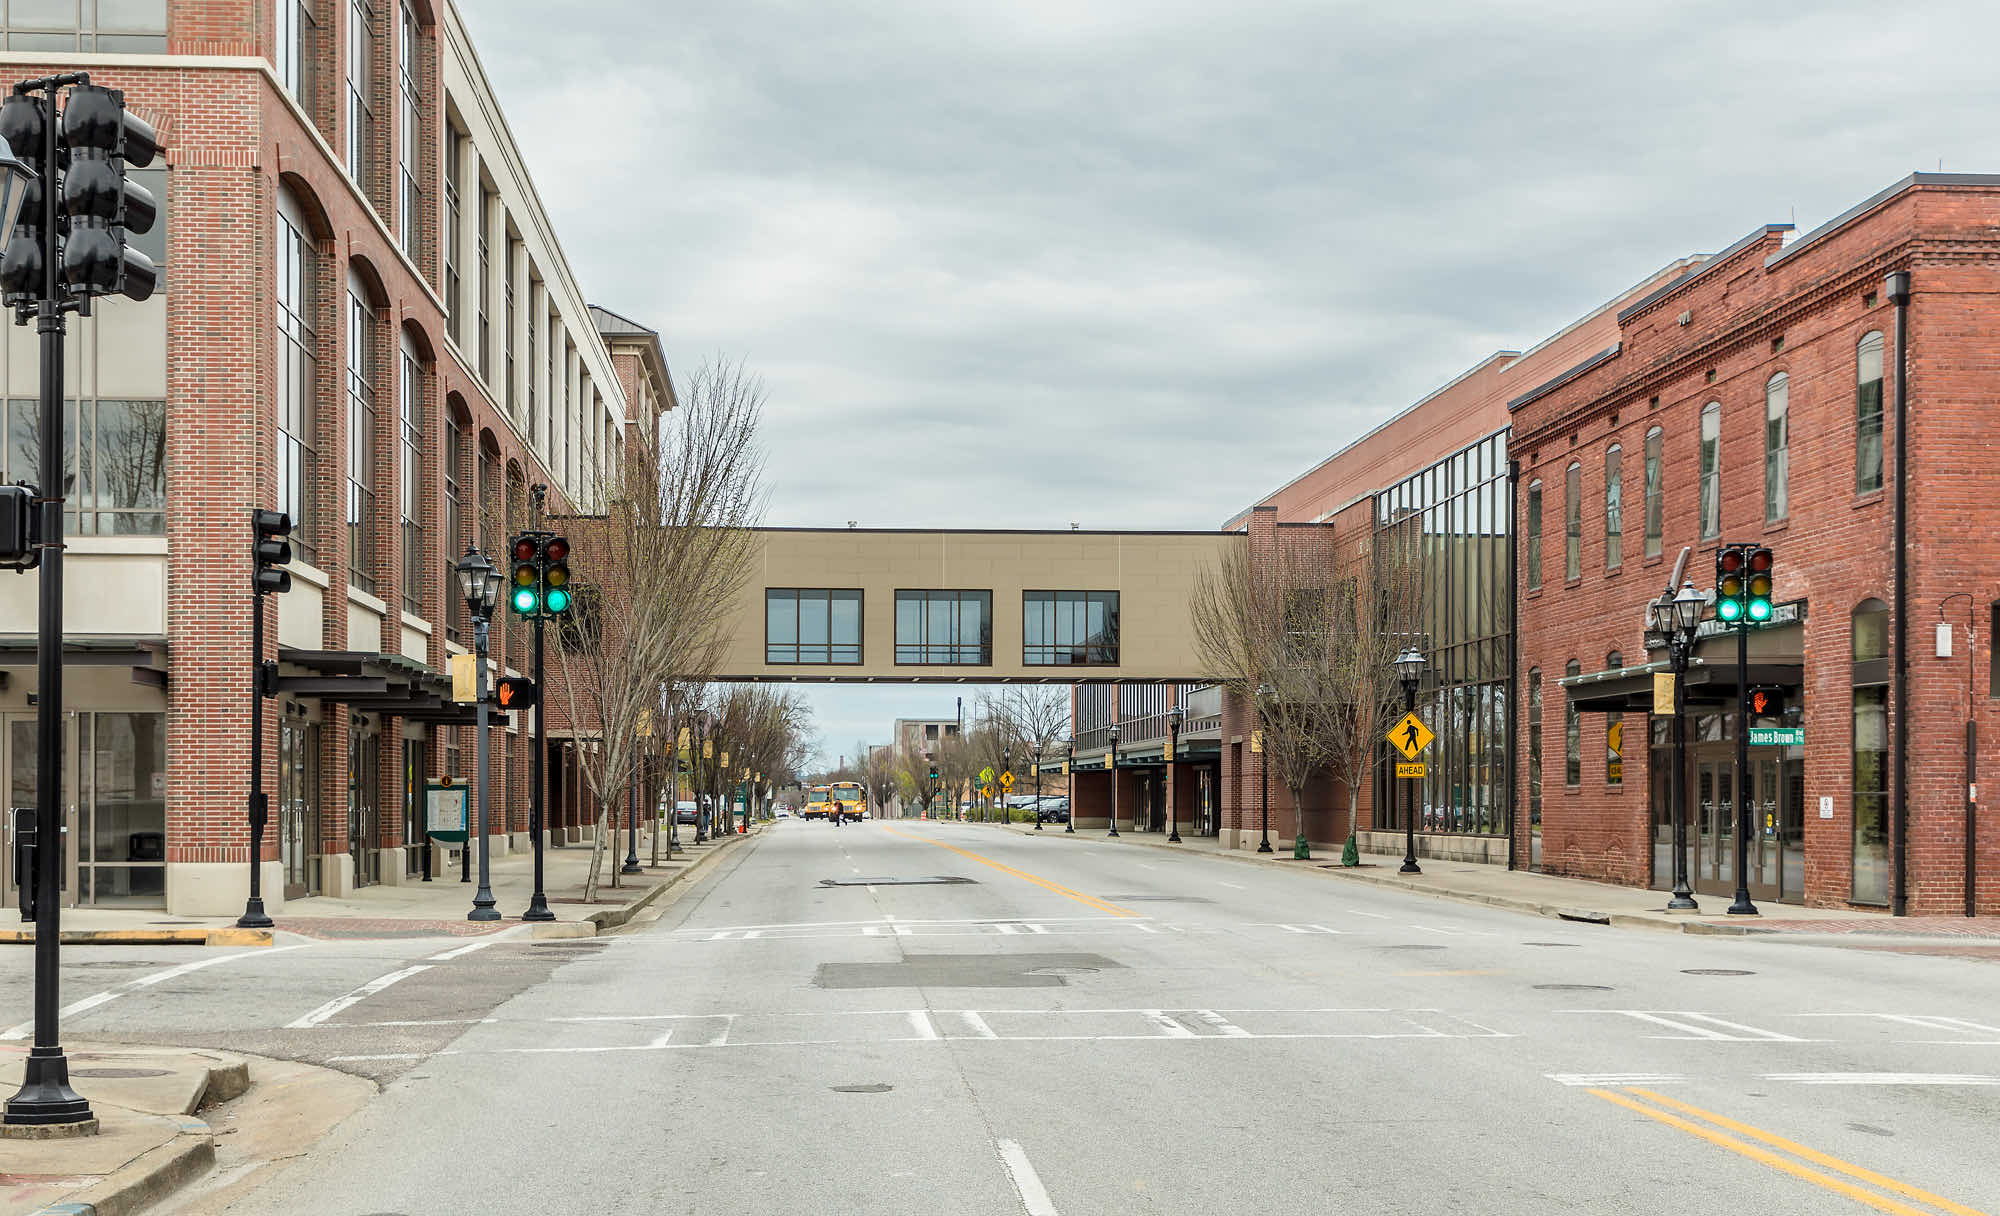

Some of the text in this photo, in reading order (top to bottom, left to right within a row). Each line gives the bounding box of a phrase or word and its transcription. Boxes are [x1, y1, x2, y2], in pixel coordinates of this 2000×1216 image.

[1750, 731, 1773, 743] James
[1773, 731, 1794, 743] Brown
[1399, 766, 1423, 775] AHEAD
